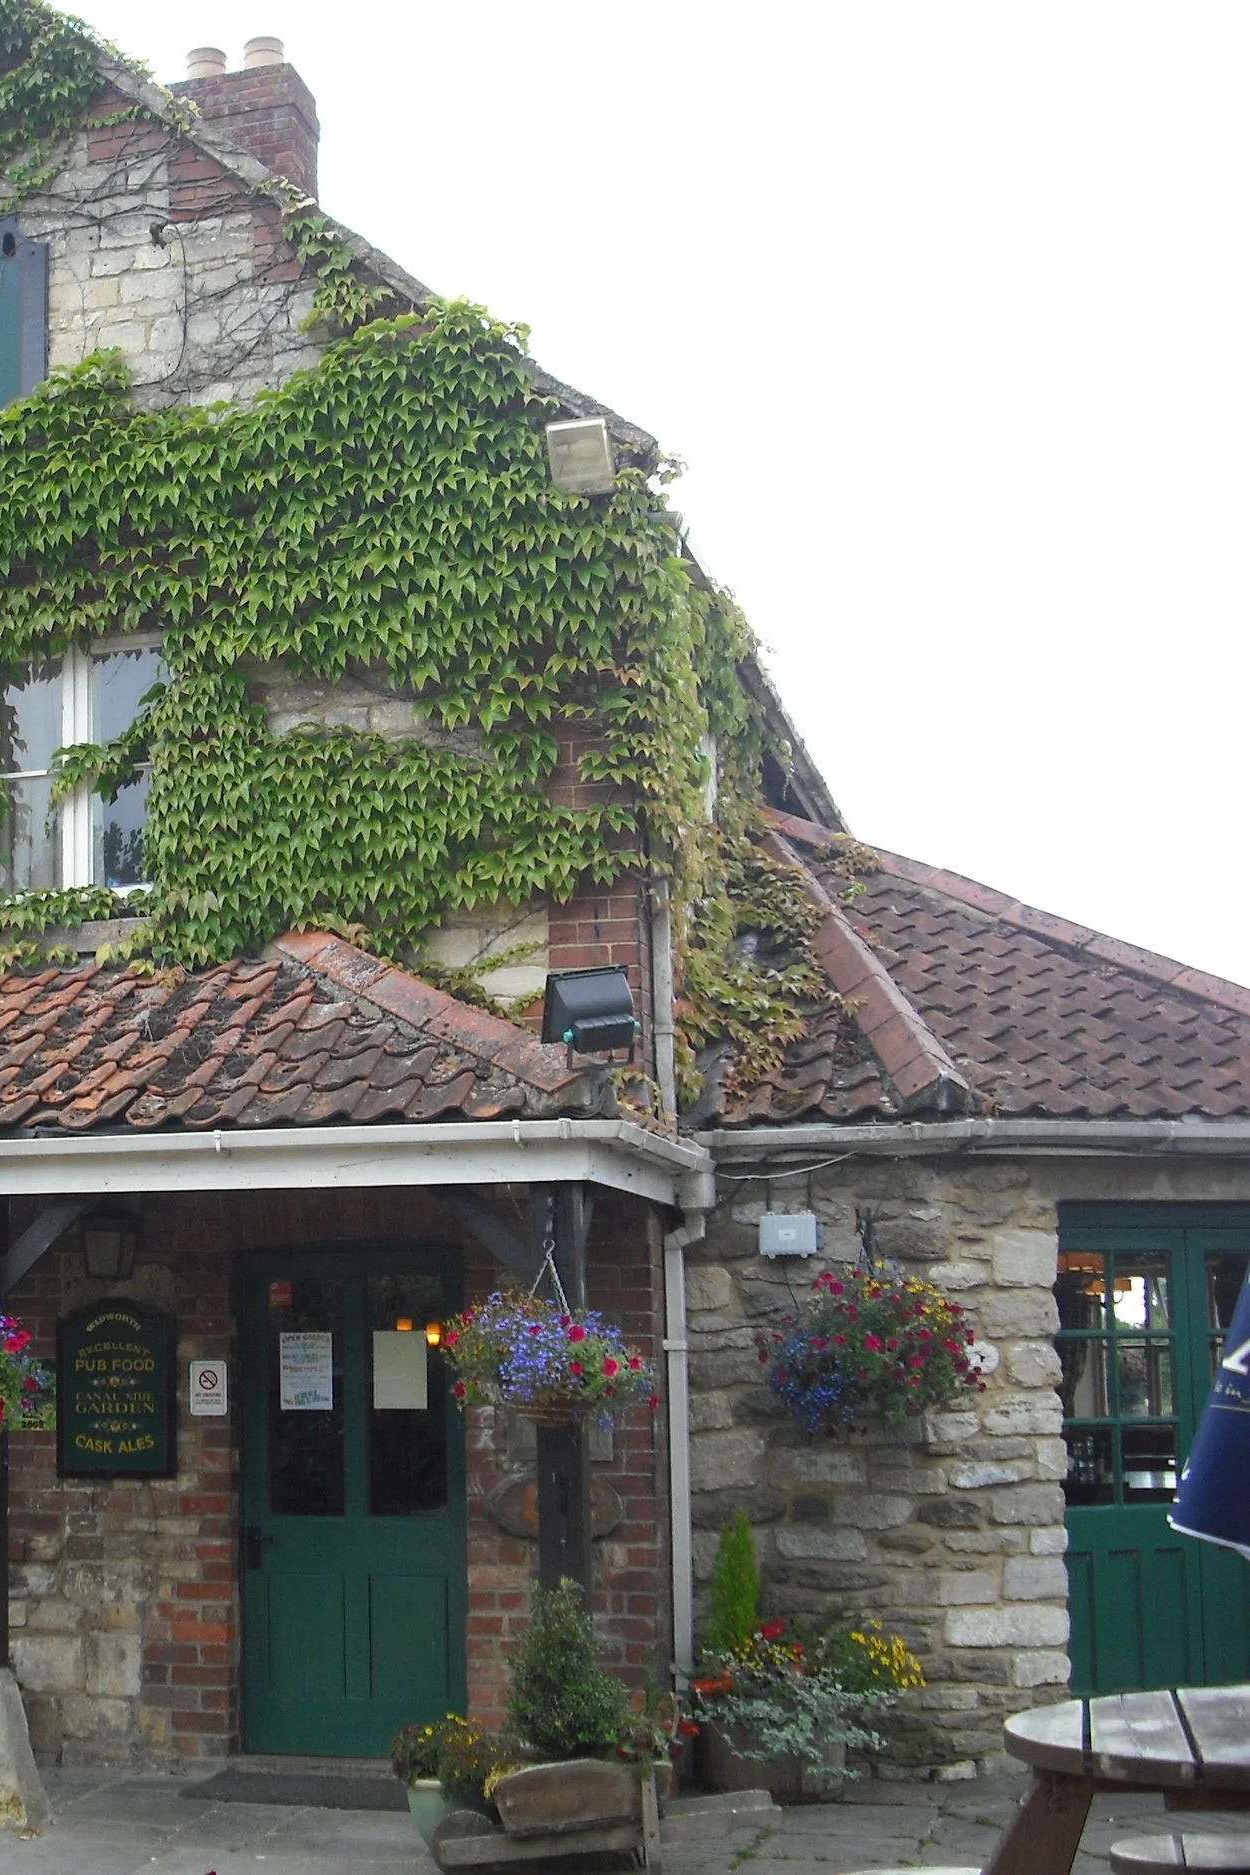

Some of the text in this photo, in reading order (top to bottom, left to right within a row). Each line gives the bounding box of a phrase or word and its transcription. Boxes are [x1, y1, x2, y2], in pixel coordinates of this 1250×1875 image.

[86, 1312, 142, 1332] WADWORTH
[78, 1342, 151, 1358] EXCELLENT
[75, 1358, 155, 1372] PUB FOOD
[76, 1391, 155, 1401] CANAL SIDE
[76, 1402, 155, 1414] GARDEN
[75, 1435, 155, 1454] CASK ALES
